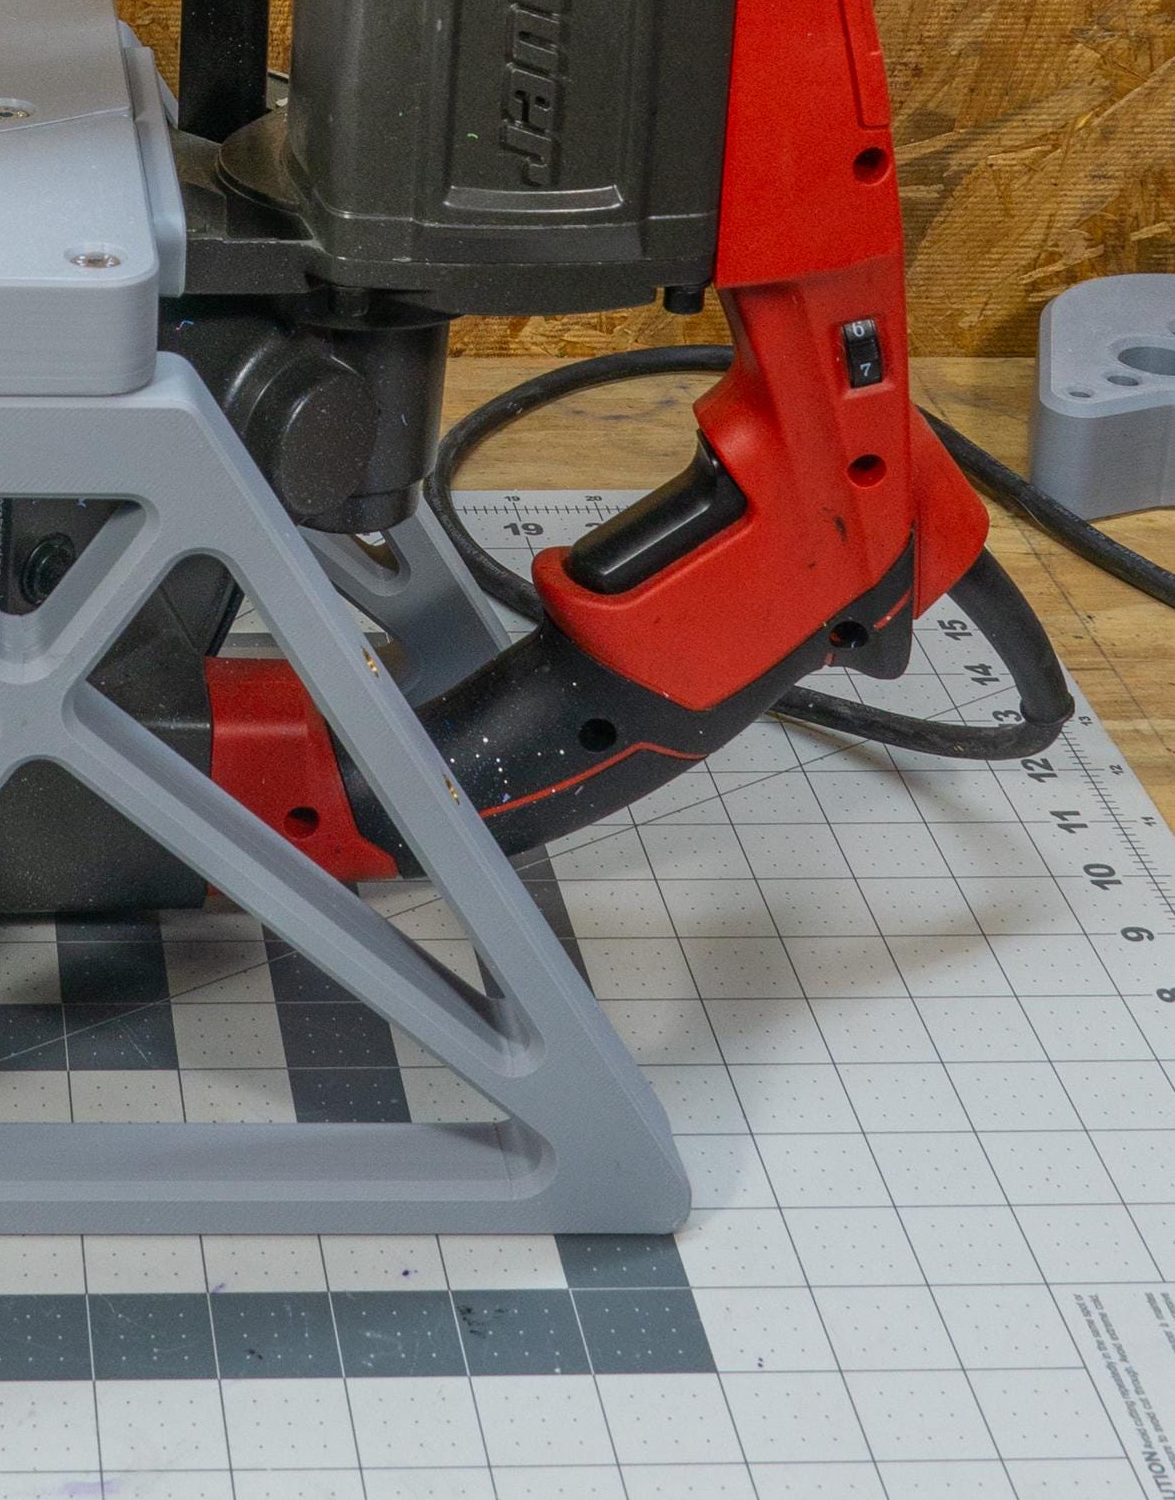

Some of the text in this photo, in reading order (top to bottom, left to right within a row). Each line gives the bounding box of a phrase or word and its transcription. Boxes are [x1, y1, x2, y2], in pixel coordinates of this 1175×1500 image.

[852, 322, 865, 337] 6
[860, 362, 872, 377] 7
[503, 523, 544, 536] 19
[937, 619, 973, 641] 15
[964, 663, 1000, 686] 14
[1078, 715, 1093, 727] 13
[1021, 757, 1058, 783] 12
[1109, 764, 1124, 775] 12
[1049, 810, 1089, 834] 11
[1141, 816, 1157, 827] 11
[1083, 863, 1122, 890] 10
[1120, 926, 1155, 942] 9
